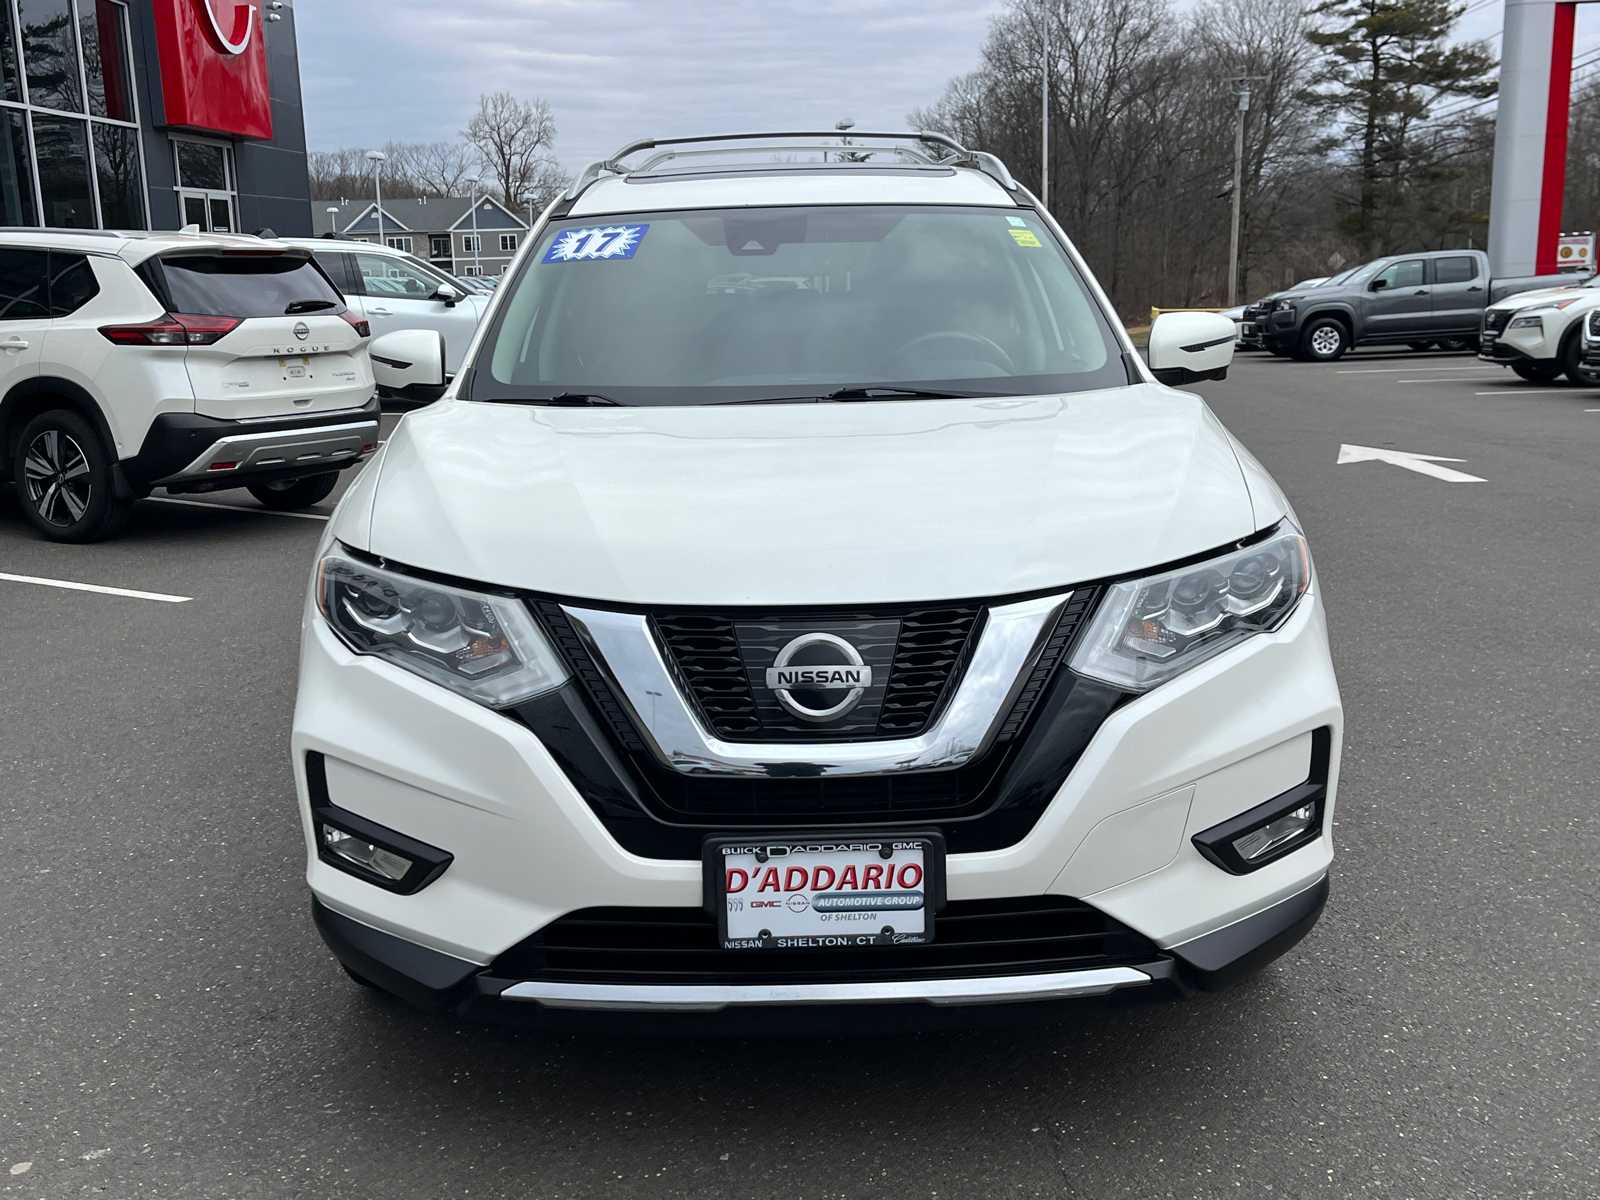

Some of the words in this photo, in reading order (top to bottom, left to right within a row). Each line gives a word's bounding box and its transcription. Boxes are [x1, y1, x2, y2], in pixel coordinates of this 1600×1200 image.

[572, 231, 622, 254] 17
[272, 345, 330, 354] ROGUE
[777, 670, 860, 684] NISSAN
[722, 846, 762, 855] BUICK
[766, 843, 882, 858] D'ADDARIO
[892, 842, 922, 850] GMC
[726, 862, 923, 894] D'ADDARIO
[750, 900, 782, 908] GMC
[818, 897, 883, 907] AUTOMOTIVE
[884, 896, 920, 905] GROUP
[820, 913, 833, 922] OF
[834, 912, 878, 921] SHELTON
[724, 939, 763, 949] NISSAN
[856, 935, 877, 945] CT
